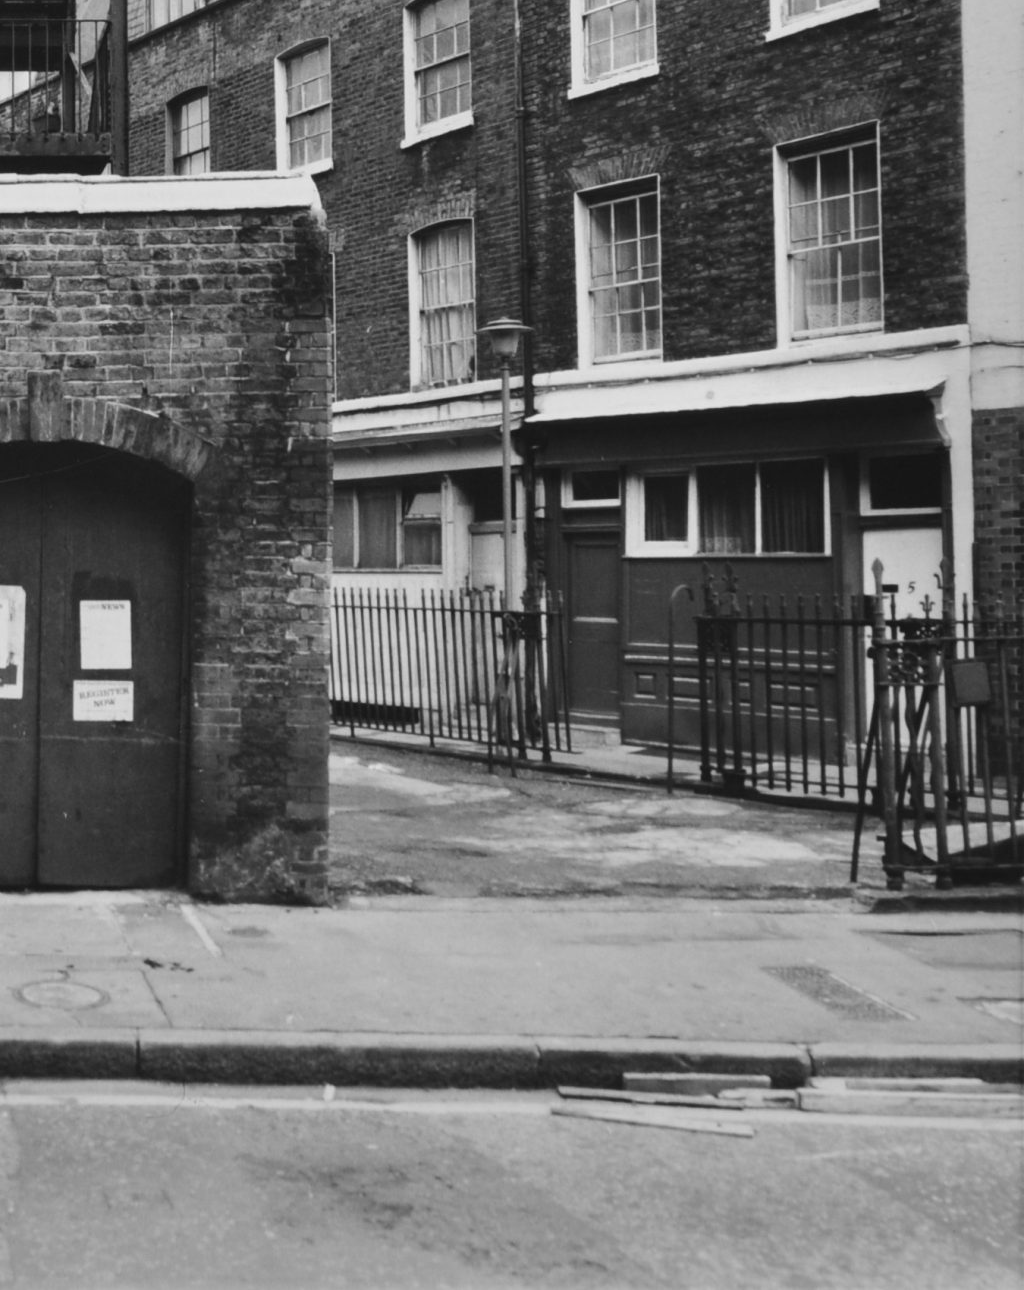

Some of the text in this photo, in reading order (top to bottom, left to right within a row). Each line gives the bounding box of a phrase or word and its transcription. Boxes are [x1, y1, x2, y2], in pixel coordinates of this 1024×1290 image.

[907, 581, 916, 594] 5
[79, 687, 129, 699] REGISTER
[94, 699, 116, 707] NOW
